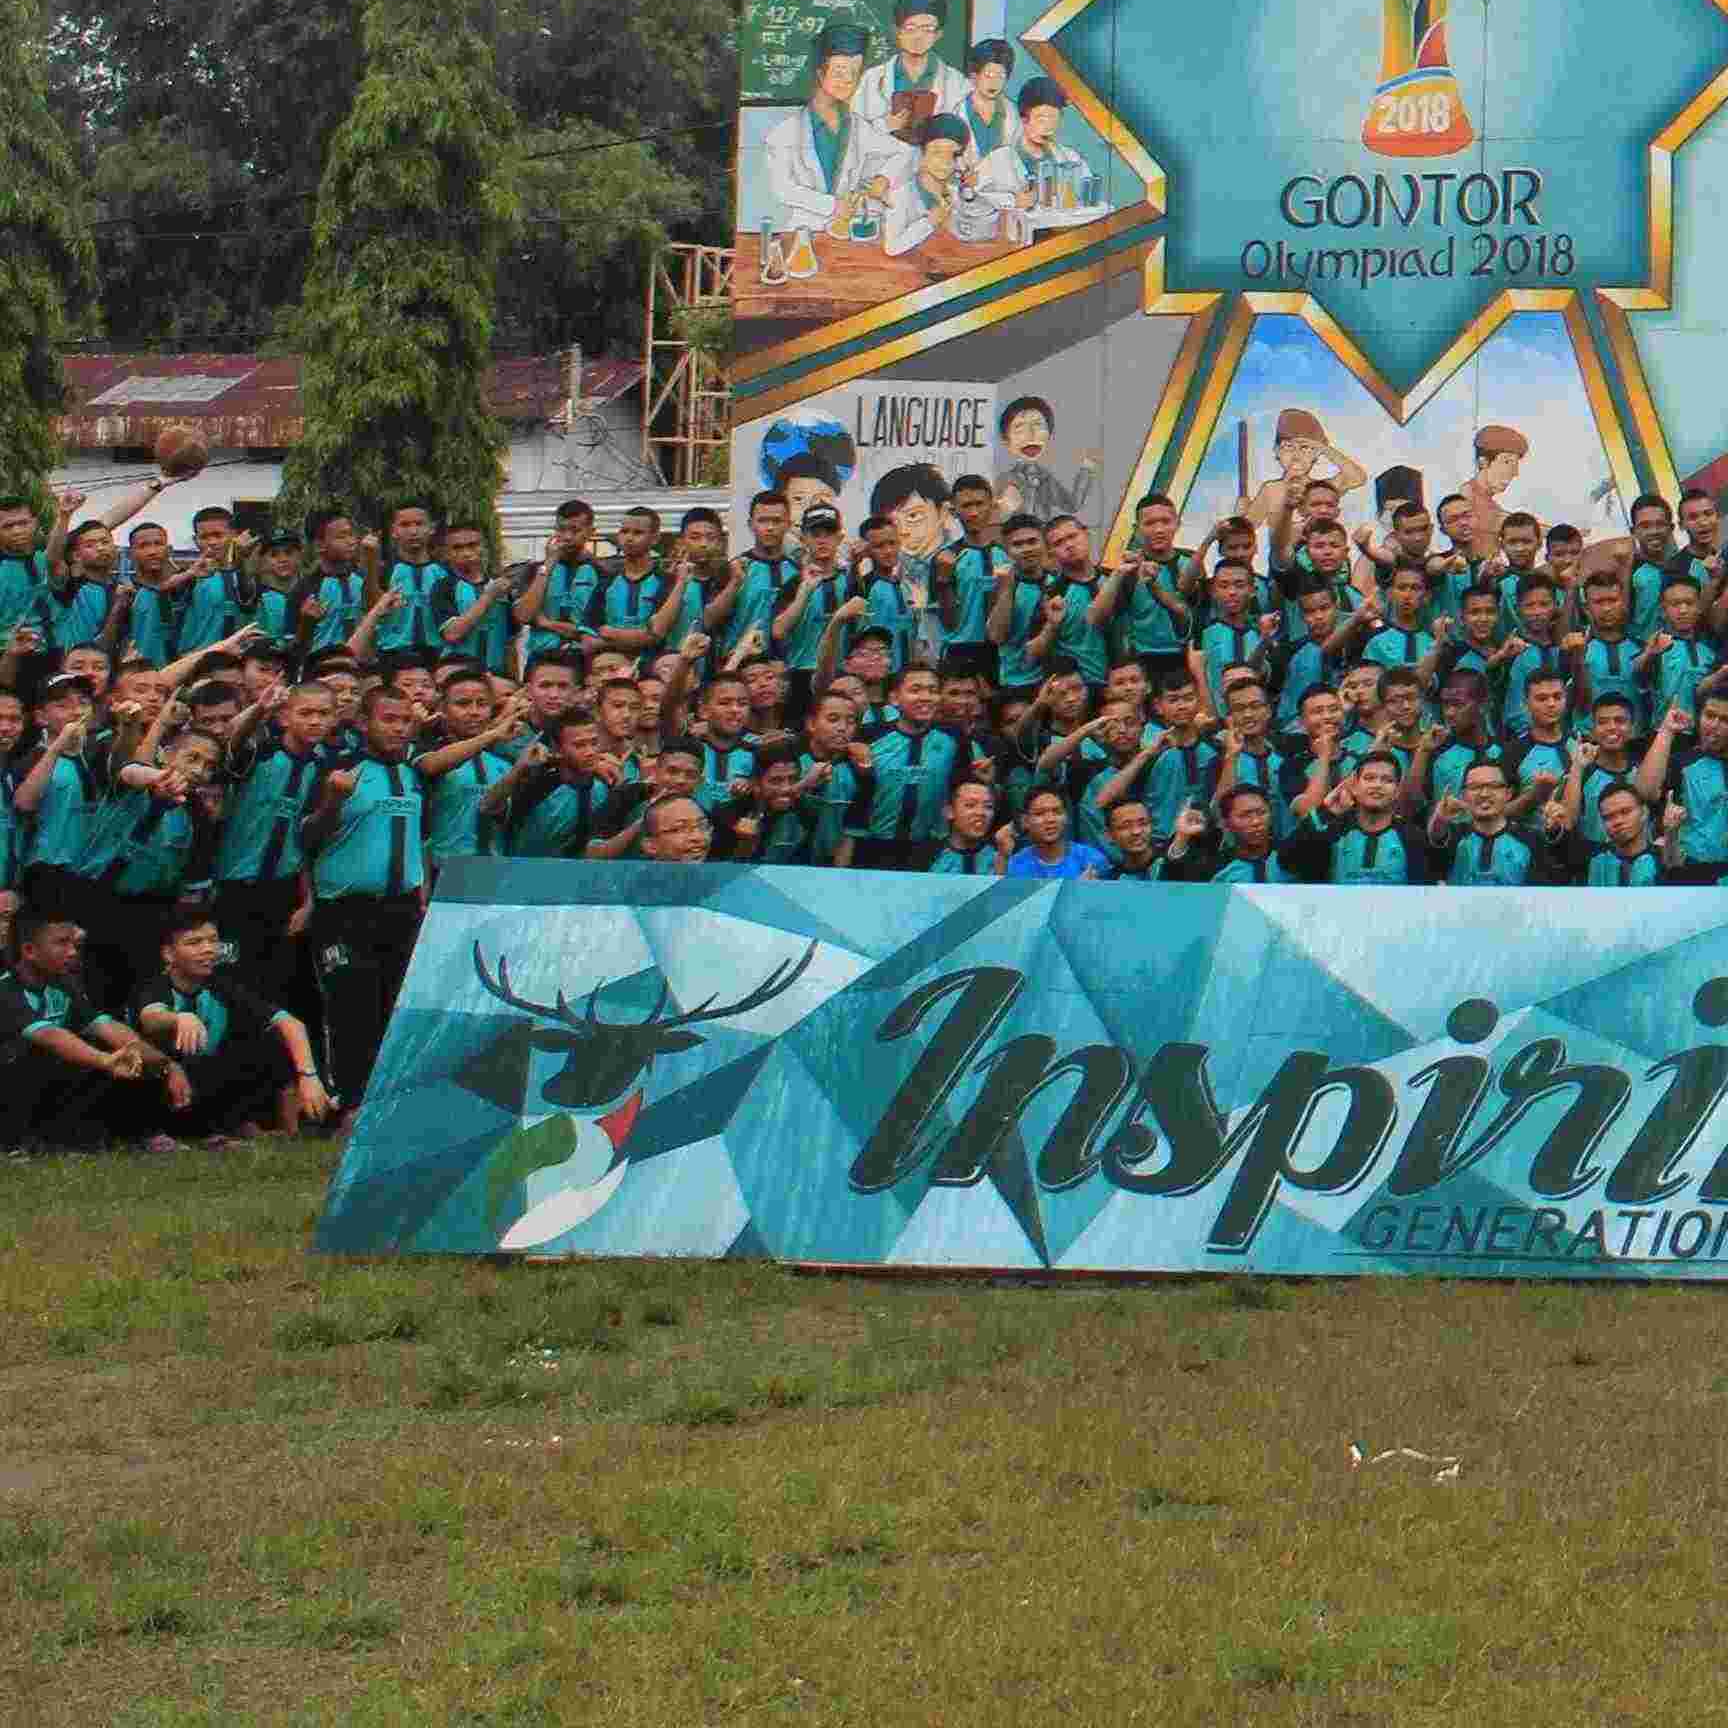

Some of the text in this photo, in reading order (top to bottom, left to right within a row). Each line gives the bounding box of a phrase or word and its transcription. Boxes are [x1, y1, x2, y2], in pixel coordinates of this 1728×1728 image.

[1375, 92, 1452, 134] 2018
[1280, 169, 1545, 229] GONTOR
[1240, 232, 1577, 289] Olympiad 2018
[856, 394, 989, 448] LANGUAGE
